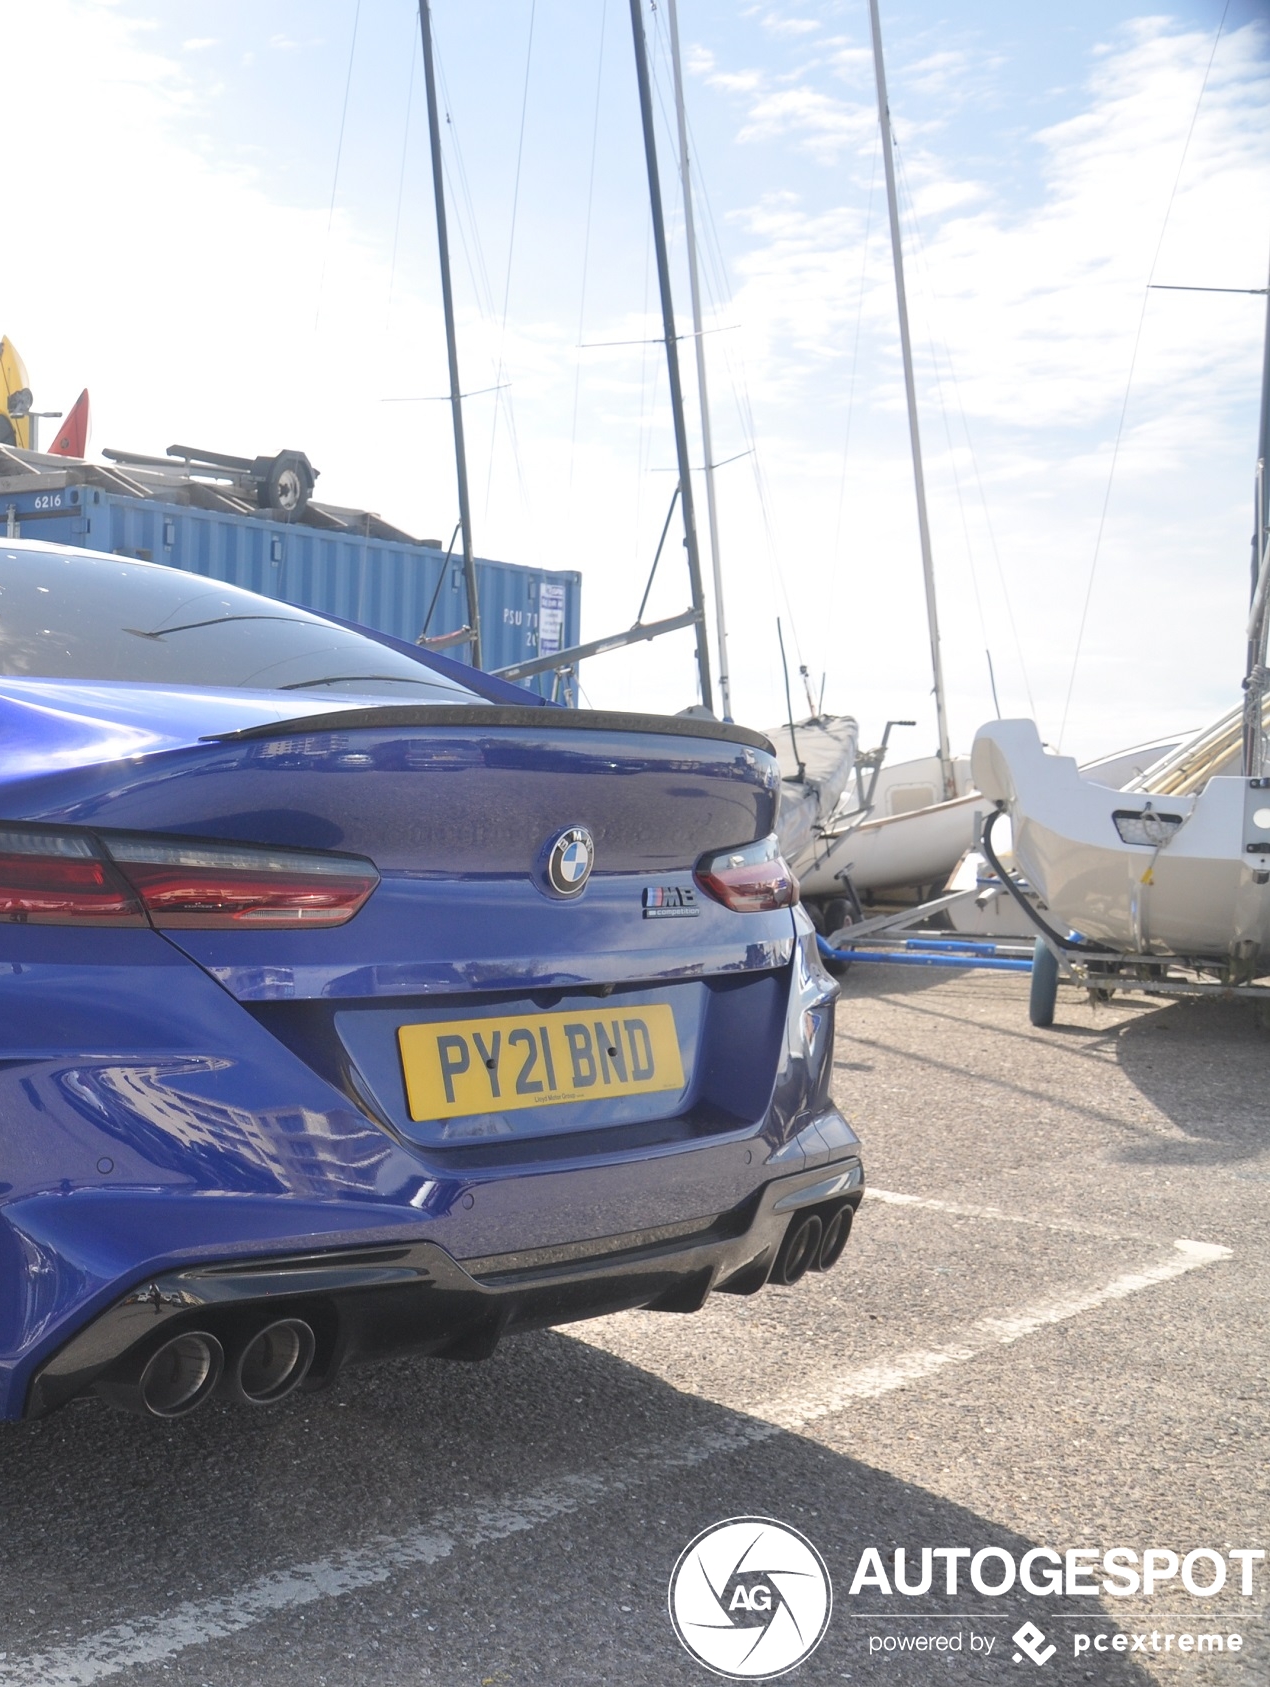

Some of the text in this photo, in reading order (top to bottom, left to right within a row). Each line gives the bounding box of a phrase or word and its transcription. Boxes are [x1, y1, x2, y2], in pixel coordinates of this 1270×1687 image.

[34, 494, 62, 509] 6216
[503, 608, 523, 626] PSU
[558, 830, 592, 852] BMW
[656, 907, 700, 917] competition
[436, 1018, 655, 1104] PY21 BND
